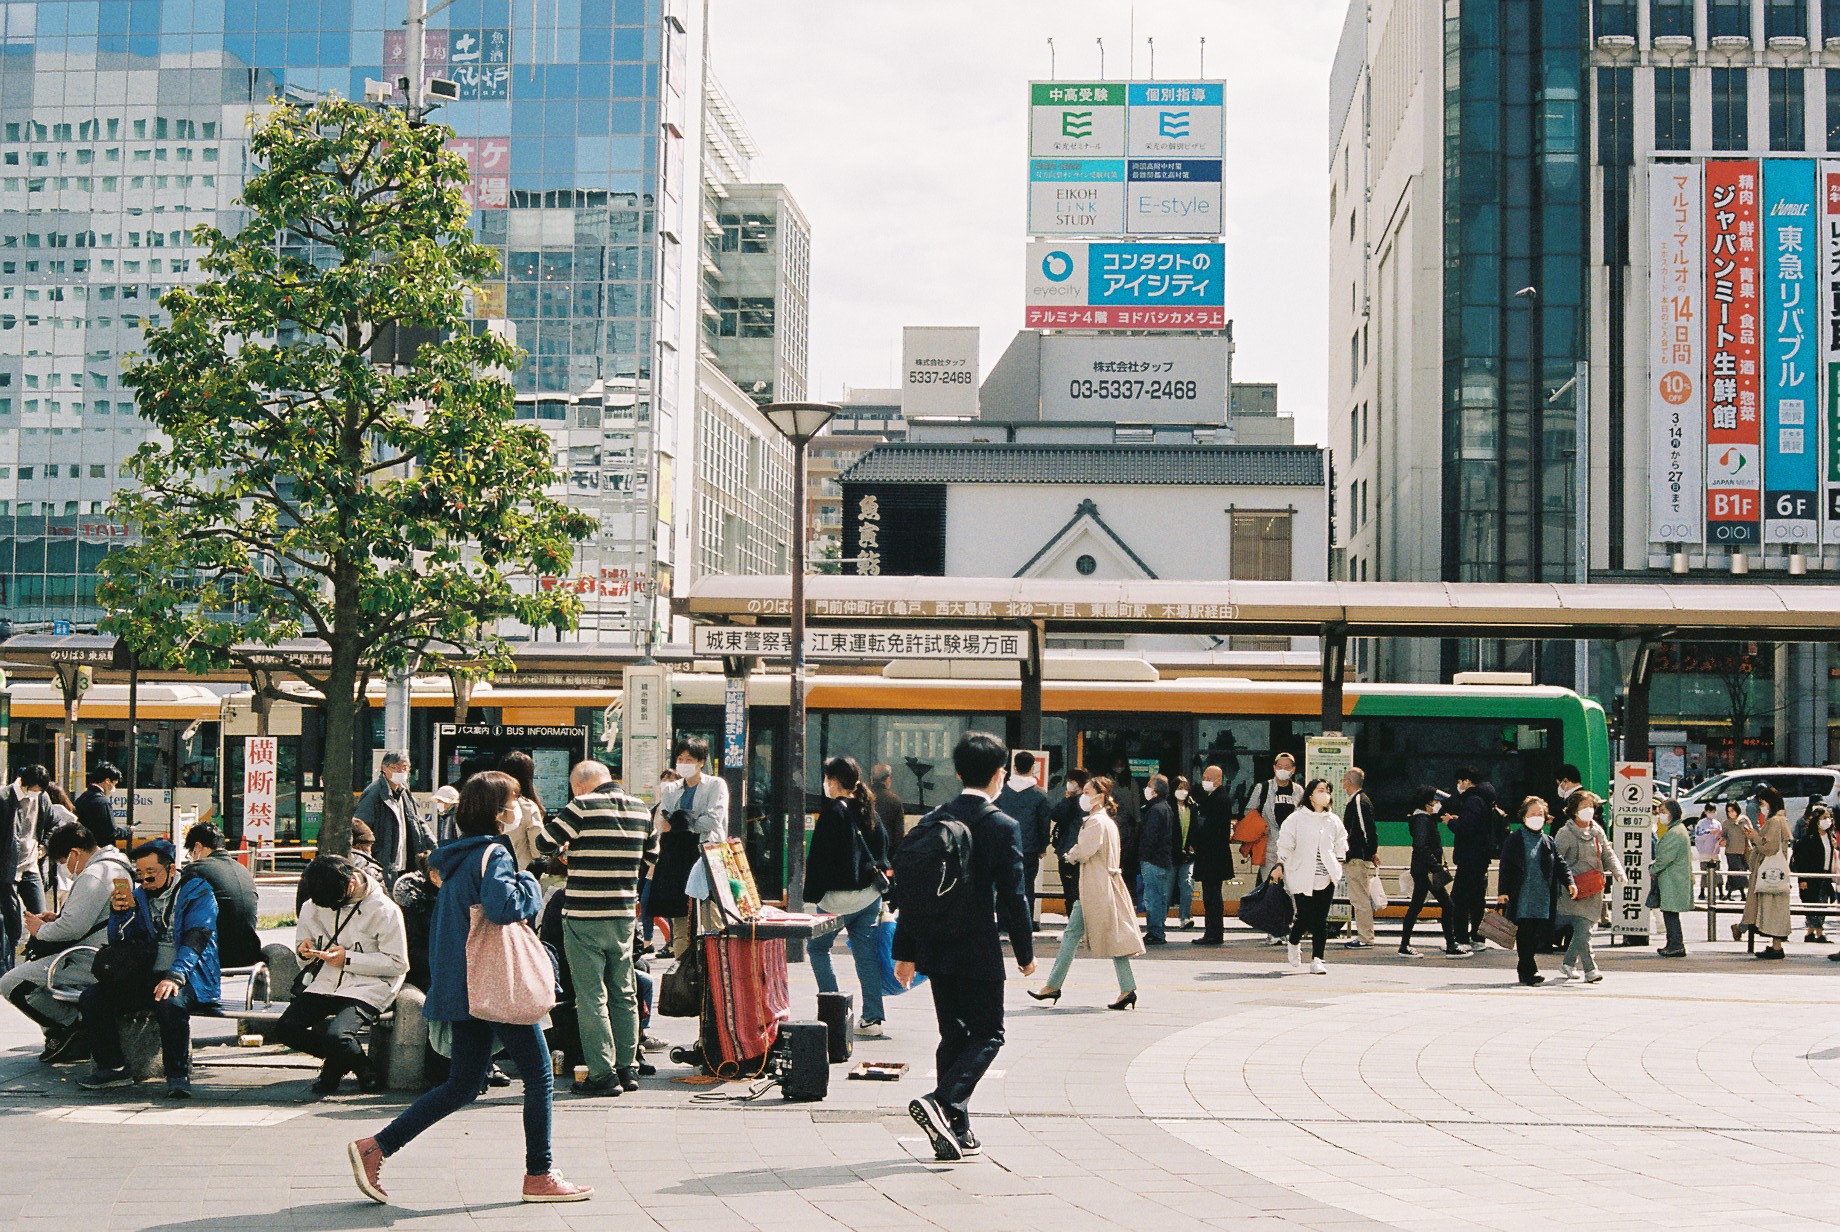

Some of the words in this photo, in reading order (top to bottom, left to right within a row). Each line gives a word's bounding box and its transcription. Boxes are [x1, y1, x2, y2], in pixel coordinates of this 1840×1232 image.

[462, 88, 506, 97] ofuro
[1049, 87, 1109, 102] 中高受験
[1146, 87, 1206, 102] 個別指導
[1056, 189, 1098, 200] EIKOH
[1139, 196, 1210, 217] E-style
[1056, 215, 1098, 226] STUDY
[1103, 253, 1211, 271] コンタクトの
[1033, 285, 1082, 297] eyecity
[1103, 274, 1210, 297] アイシティ
[1711, 184, 1738, 431] ジャパンミート生鮮館
[1777, 226, 1805, 387] 東急リバブル
[1029, 311, 1108, 325] テルミナ4階
[1118, 311, 1223, 326] ヨドバシカメラ上
[915, 359, 966, 367] 株式会社タップ
[1093, 361, 1174, 373] 株式会社タップ
[909, 371, 971, 384] 5337-2468
[1069, 379, 1197, 400] 03-5337-2468
[1714, 494, 1752, 516] B1F
[747, 600, 793, 613] のりば
[812, 632, 1018, 655] 江東運転免許試験場方面
[51, 650, 85, 660] のりば3
[79, 677, 89, 690] 3
[506, 727, 525, 736] BUS
[527, 727, 585, 736] INFORMATION
[110, 795, 128, 808] tep
[1634, 818, 1643, 826] 07
[1623, 832, 1642, 920] 門前仲町行
